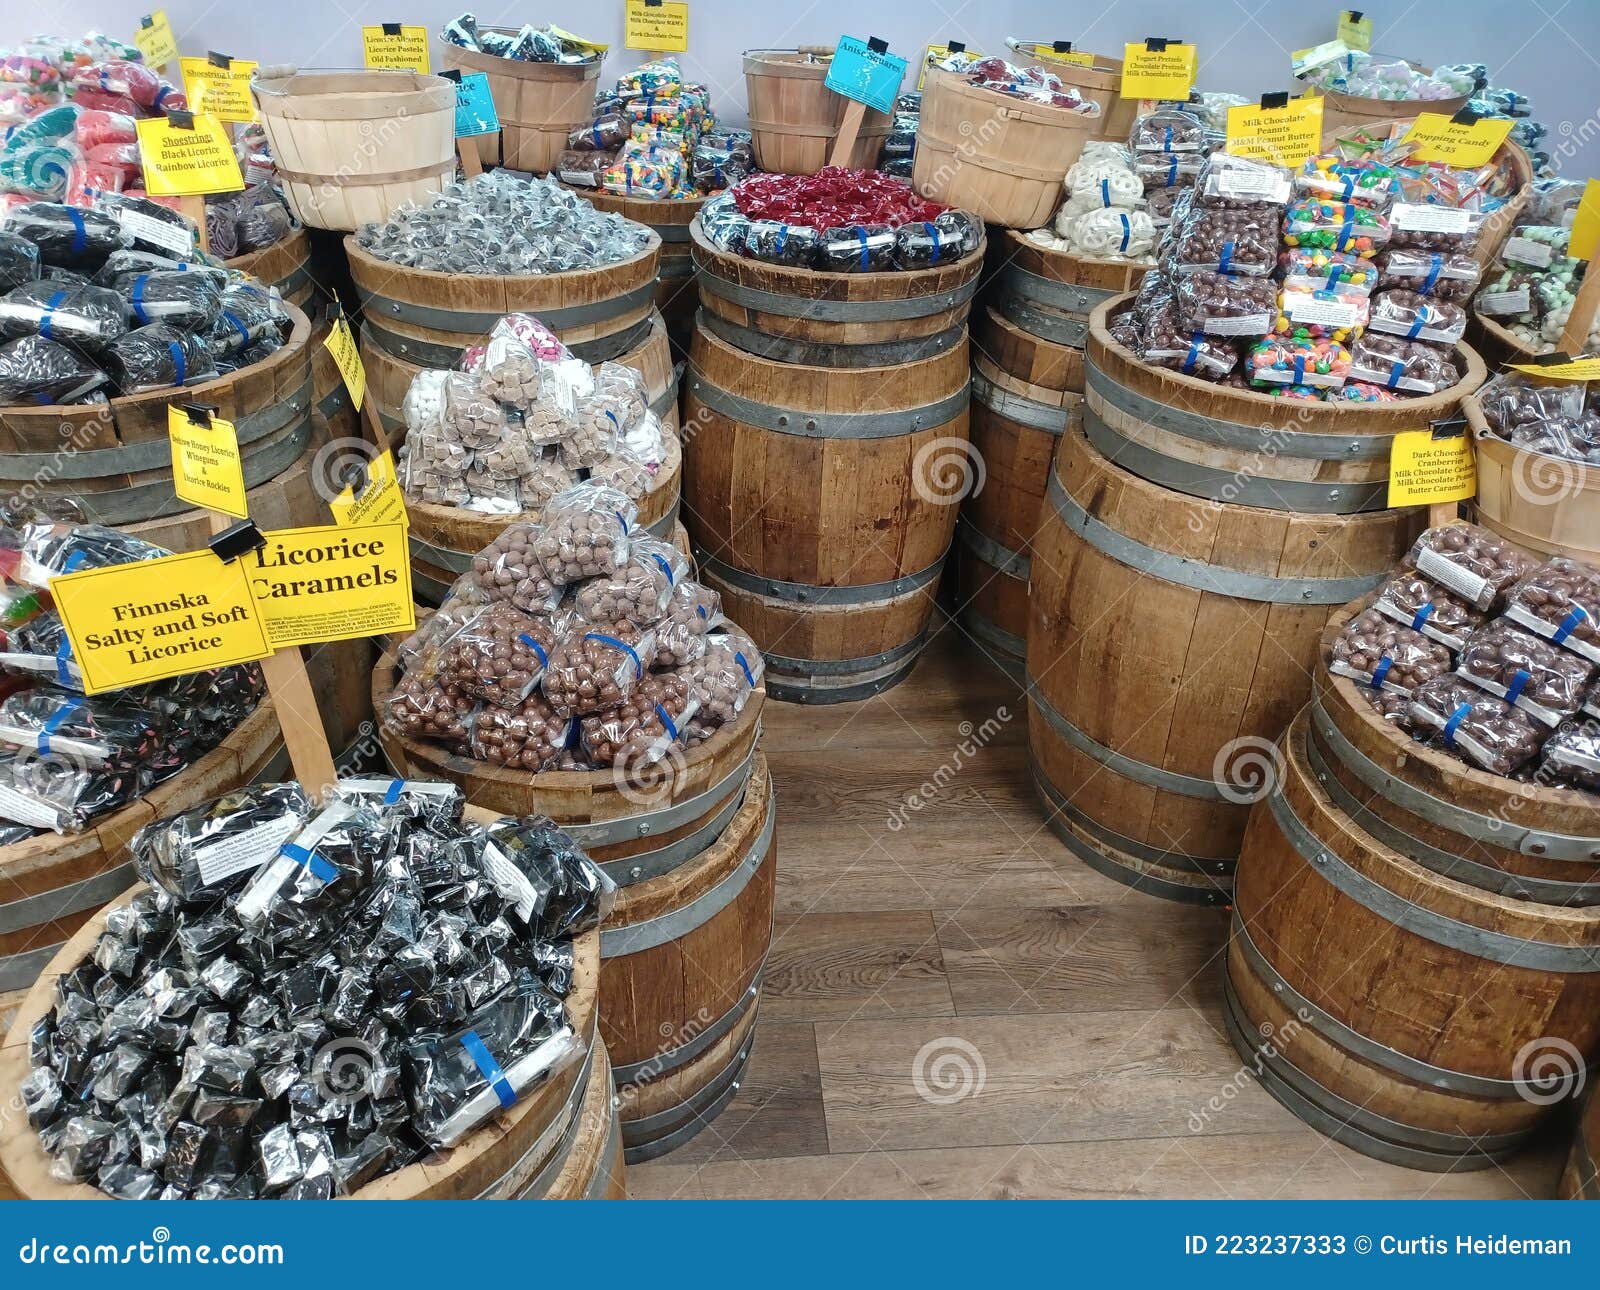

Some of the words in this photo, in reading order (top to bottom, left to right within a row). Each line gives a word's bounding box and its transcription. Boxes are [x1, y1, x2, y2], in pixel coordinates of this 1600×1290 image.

[840, 42, 866, 57] Anise
[1242, 118, 1262, 128] Milk
[1264, 114, 1306, 126] Chocolate
[1257, 126, 1290, 135] Peanuts
[1268, 142, 1310, 152] Chocolate
[1414, 132, 1456, 144] Popping
[1458, 138, 1491, 148] Candy
[162, 150, 186, 160] Black
[188, 146, 220, 156] Licorice
[156, 162, 196, 172] Rainbow
[198, 158, 230, 168] Licorice
[191, 440, 210, 454] Honey
[211, 445, 235, 458] Licorice
[1412, 450, 1432, 459] Dark
[186, 450, 219, 466] Winegums
[202, 466, 207, 475] &
[1395, 470, 1412, 478] Milk
[1414, 467, 1452, 476] Chocolate
[184, 472, 206, 486] Licorice
[206, 480, 231, 494] Rockies
[1396, 478, 1414, 486] Milk
[1416, 476, 1454, 485] Chocolate
[347, 502, 360, 520] Milk
[256, 538, 385, 569] Licorice
[252, 564, 398, 600] Caramels
[112, 591, 210, 622] Finnska
[85, 624, 150, 650] Salty
[153, 614, 196, 636] and
[201, 605, 250, 628] Soft
[127, 634, 223, 664] Licorice
